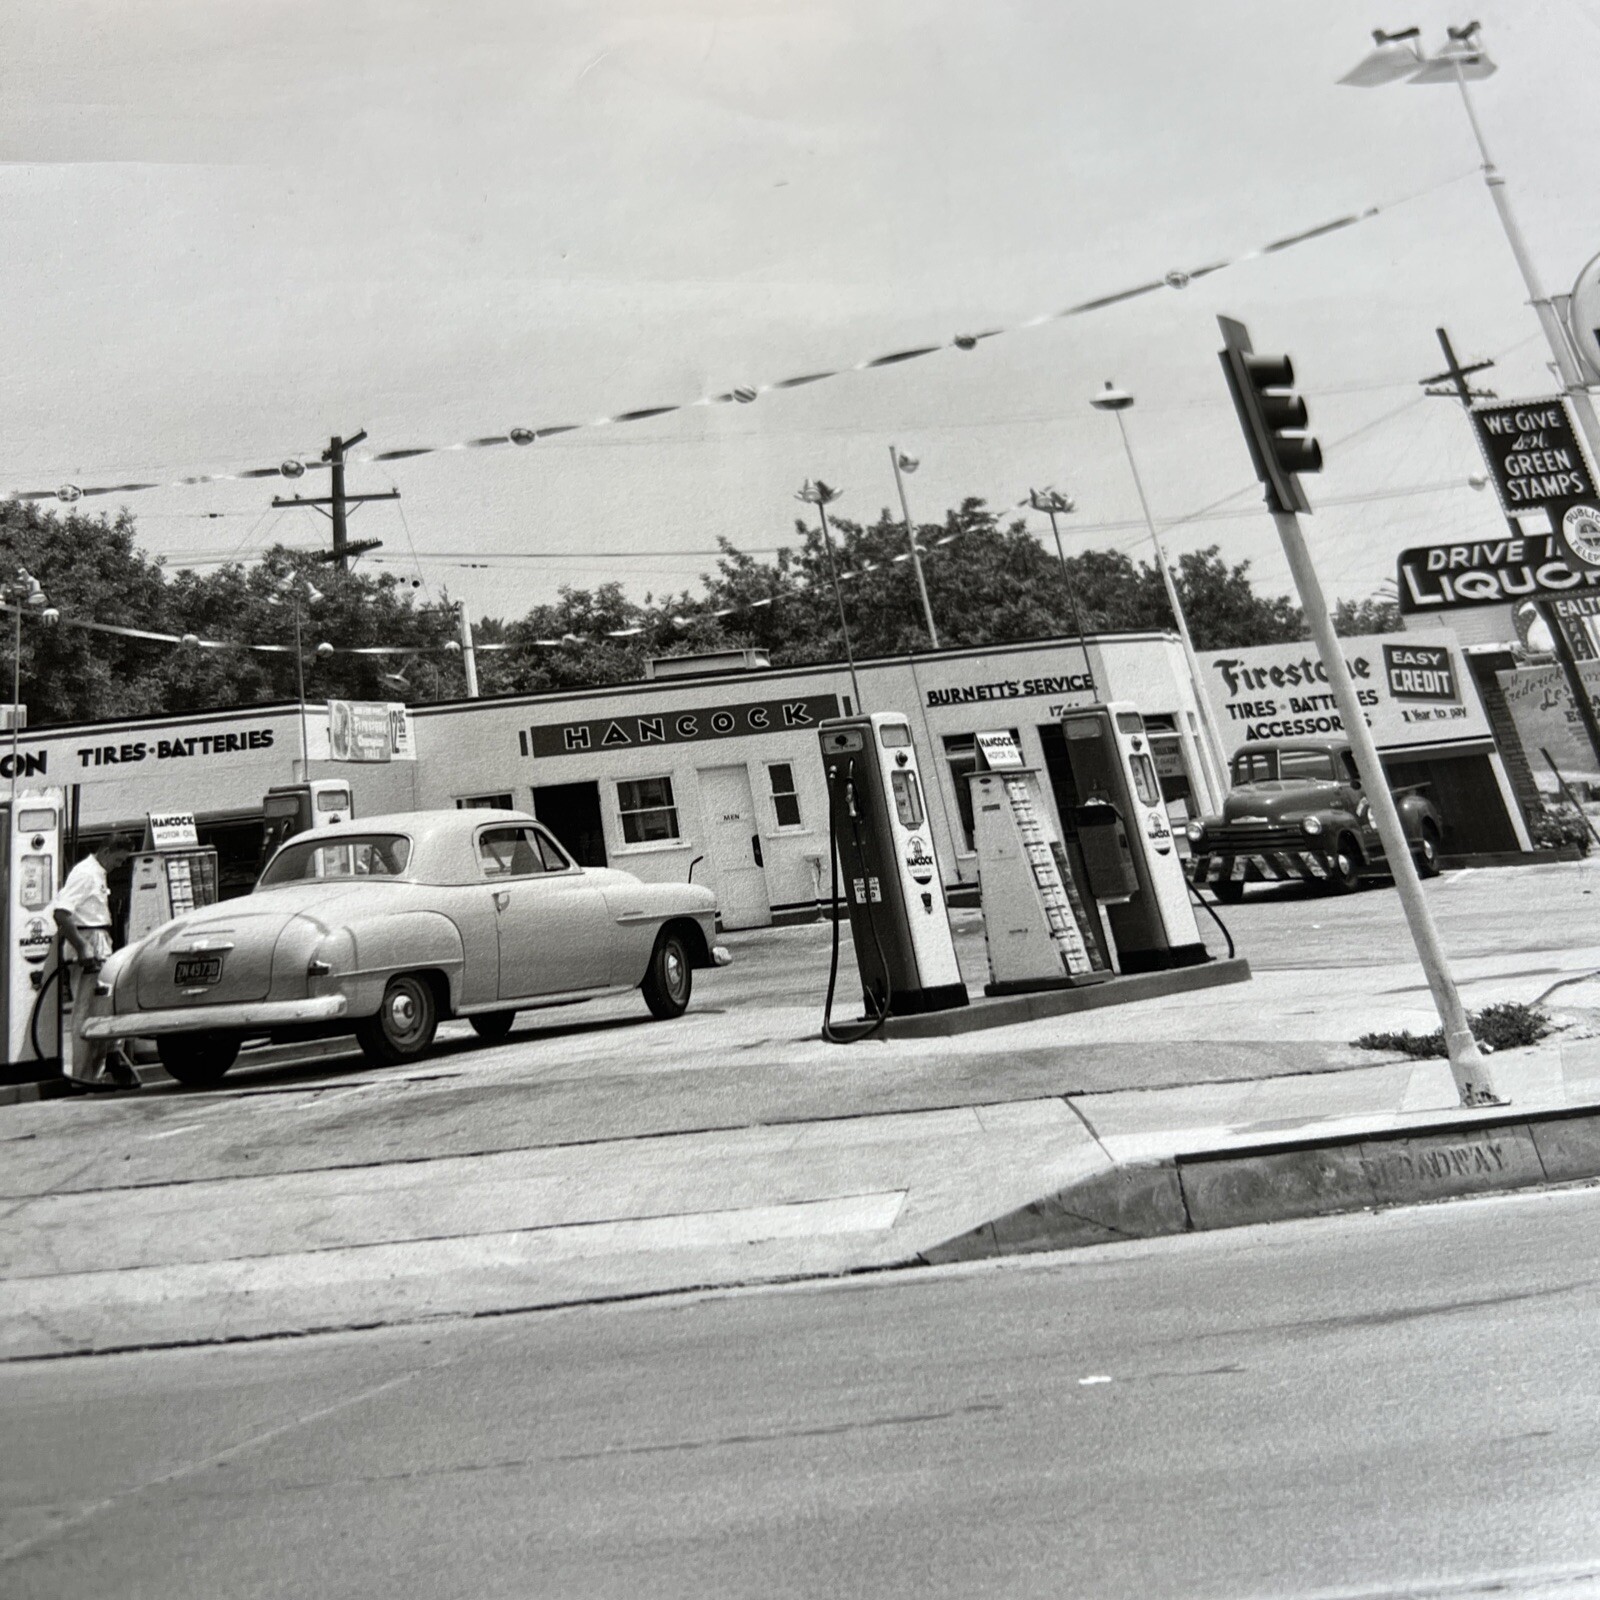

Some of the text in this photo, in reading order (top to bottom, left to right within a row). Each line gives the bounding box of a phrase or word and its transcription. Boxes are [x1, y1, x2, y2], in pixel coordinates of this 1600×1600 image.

[1483, 410, 1561, 435] WE GIVE
[1504, 448, 1571, 476] GREEN
[1506, 472, 1584, 501] STAMPS
[1566, 508, 1600, 524] PUBLIC
[1427, 540, 1525, 571] DRIVE
[1556, 597, 1600, 617] EALT
[1391, 651, 1441, 666] EASY
[1022, 674, 1094, 695] SERVICE
[1213, 656, 1371, 697] Firestoe
[1390, 669, 1450, 694] CREDIT
[1225, 689, 1379, 720] TIRES BATTES
[1434, 708, 1446, 719] to
[1450, 707, 1467, 718] pay
[564, 703, 813, 750] HANCOCK
[1246, 712, 1372, 741] ACCESSOR
[78, 743, 147, 767] TIRES
[157, 729, 274, 759] BATTERIES
[979, 736, 1014, 747] HANCOCK
[152, 815, 194, 828] HANCOCK
[906, 855, 933, 866] HANCOCK
